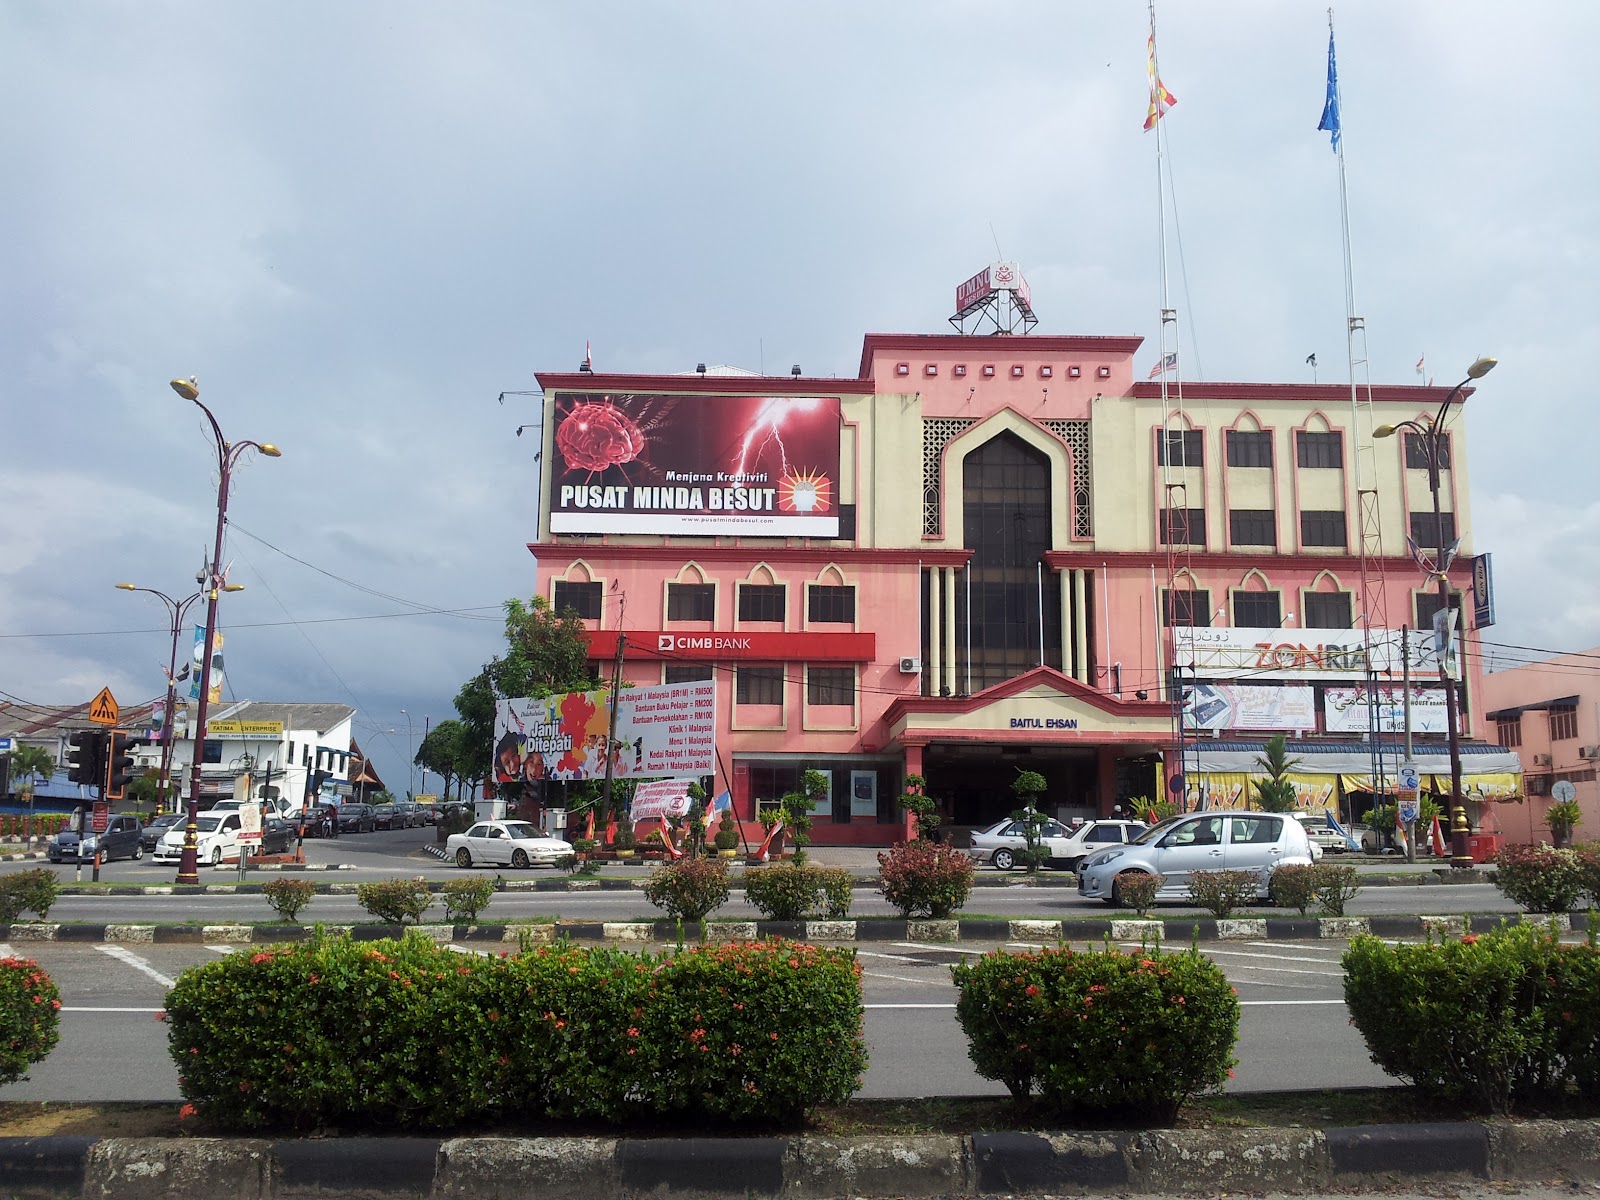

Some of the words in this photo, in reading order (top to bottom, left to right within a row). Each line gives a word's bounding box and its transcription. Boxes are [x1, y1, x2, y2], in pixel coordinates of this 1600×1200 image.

[958, 268, 990, 301] UMNO
[964, 289, 985, 305] BESUT
[666, 471, 713, 483] Menjana
[717, 472, 768, 482] Kreativiti
[560, 485, 629, 509] PUSAT
[633, 486, 704, 510] MINDA
[709, 488, 775, 510] BESUT
[677, 637, 713, 649] CIMB
[714, 638, 751, 649] BANK
[1255, 642, 1366, 669] ZONRIA
[626, 694, 642, 702] Rakyat
[648, 691, 669, 700] Malaysia
[671, 689, 688, 699] (BR1M)
[695, 687, 713, 695] RM500
[635, 704, 655, 712] Bantuan
[670, 701, 688, 710] Pelajar
[695, 699, 713, 707] RM200
[633, 715, 653, 724] Bantuan
[654, 713, 688, 723] Persekolahan
[695, 712, 712, 720] RM100
[1010, 718, 1043, 728] BAITUL
[1046, 719, 1077, 728] EHSAN
[531, 720, 559, 739] Janji
[669, 725, 683, 733] Klinik
[689, 724, 712, 733] Malaysia
[527, 735, 573, 755] Ditepati
[689, 736, 712, 745] Malaysia
[665, 750, 682, 759] Rakyat
[688, 748, 711, 758] Malaysia
[671, 762, 692, 770] Malaysia
[694, 760, 711, 770] (Baiki)
